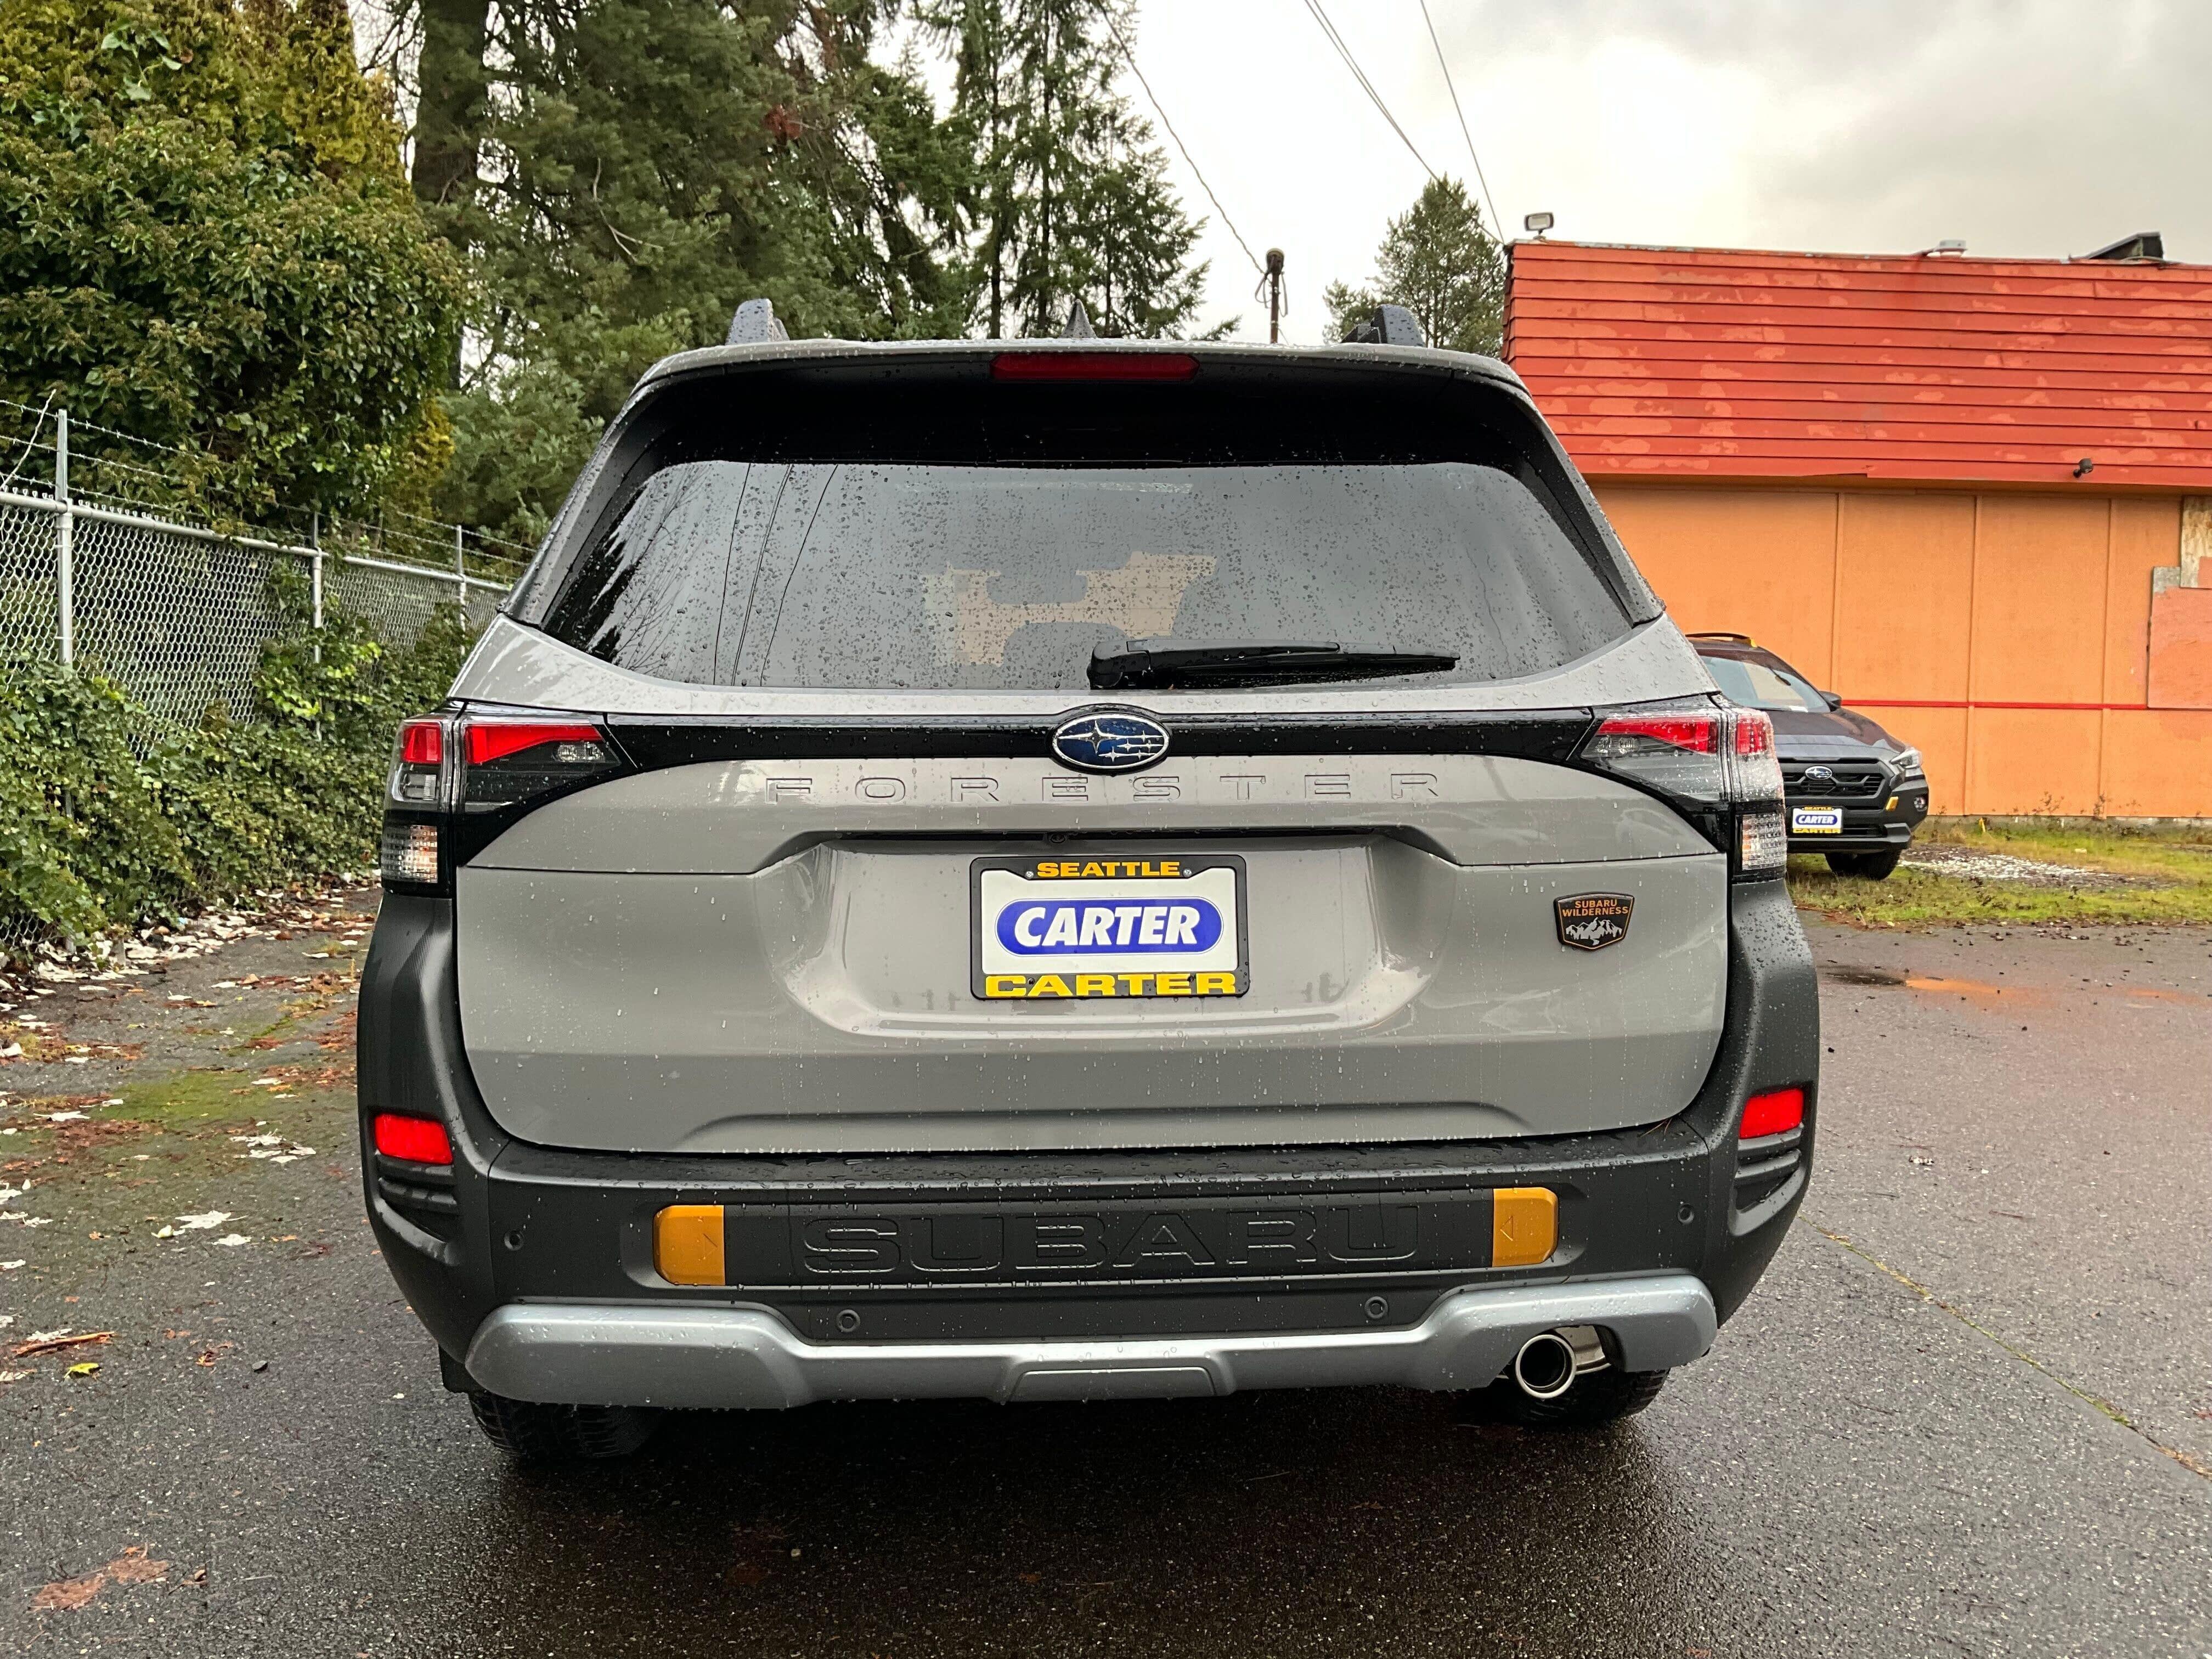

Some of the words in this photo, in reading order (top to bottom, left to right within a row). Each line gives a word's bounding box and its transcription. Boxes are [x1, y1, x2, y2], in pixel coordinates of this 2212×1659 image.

[765, 773, 1439, 804] FORESTER
[1798, 815, 1835, 824] CARTER
[1036, 861, 1181, 878] SEATTLE
[1562, 906, 1629, 917] WILDERNESS
[1575, 899, 1618, 909] SUBARU
[1014, 906, 1201, 947] CARTER
[985, 972, 1236, 997] CARTER
[803, 1206, 1420, 1273] SUBARU
